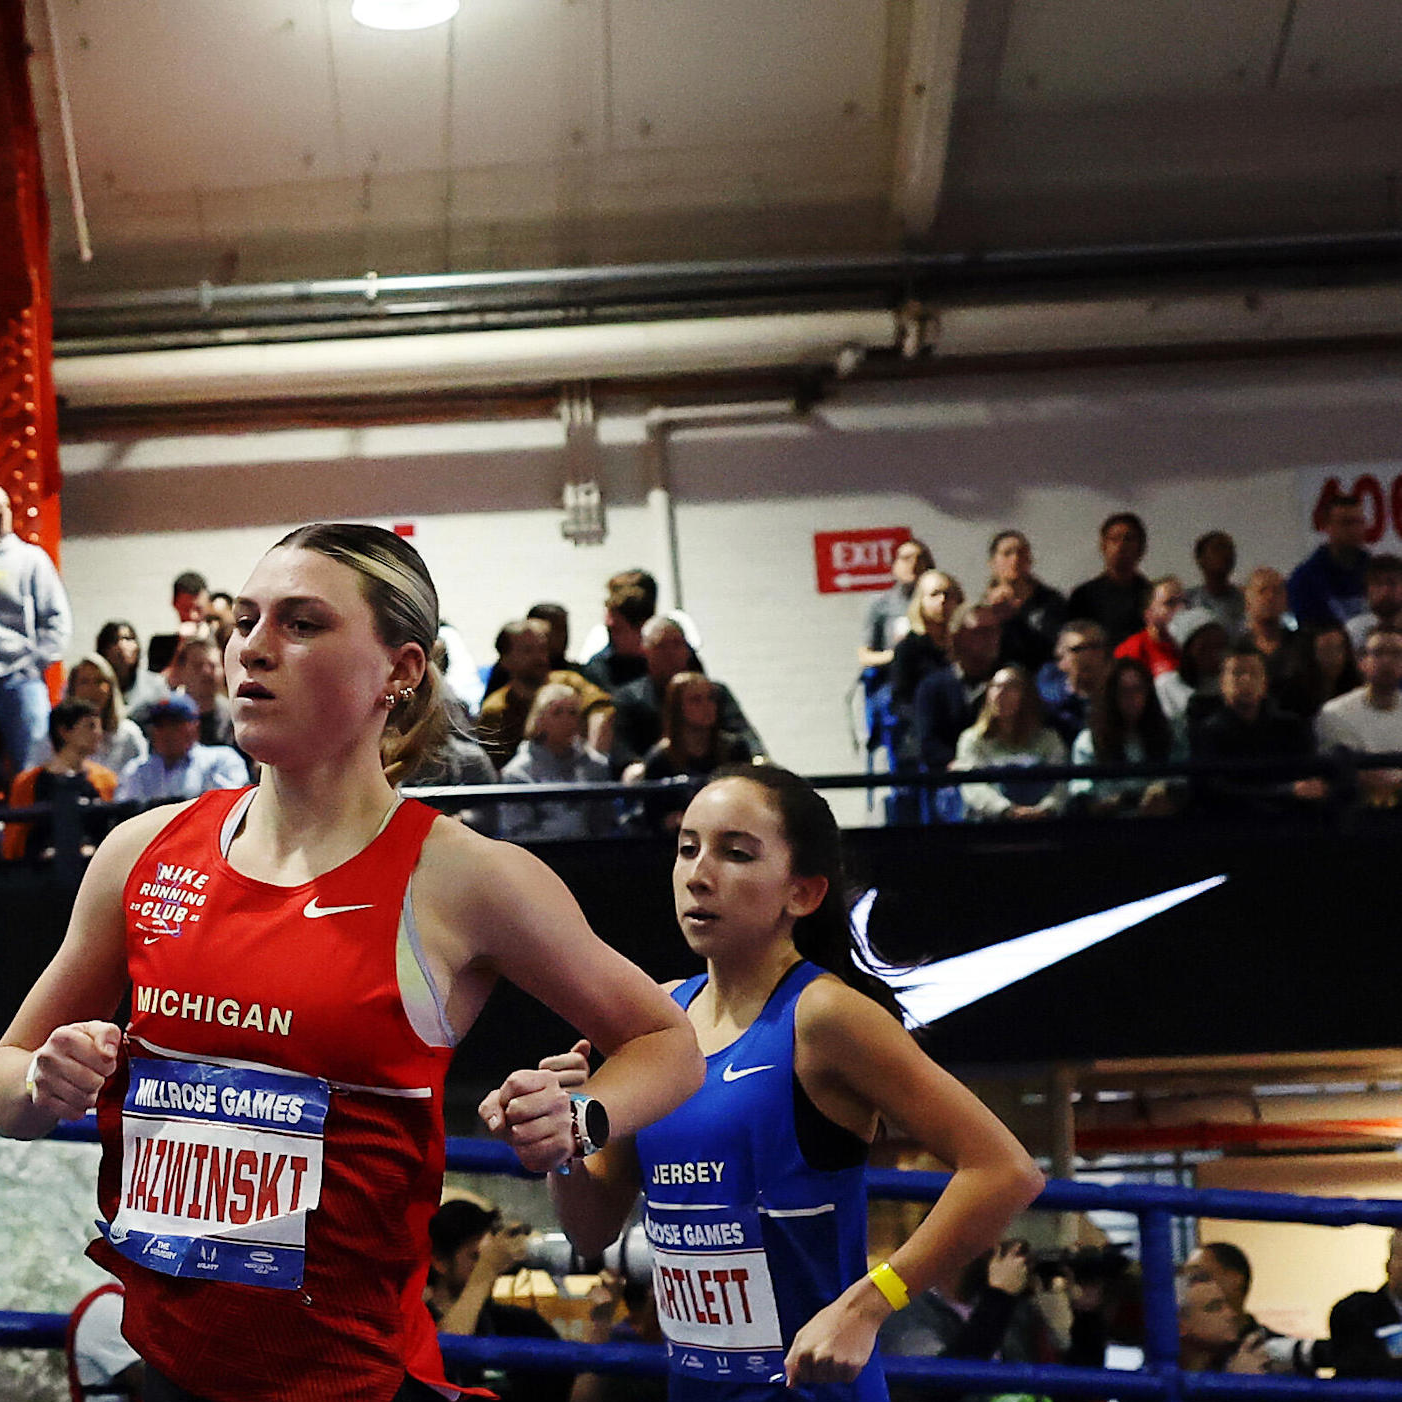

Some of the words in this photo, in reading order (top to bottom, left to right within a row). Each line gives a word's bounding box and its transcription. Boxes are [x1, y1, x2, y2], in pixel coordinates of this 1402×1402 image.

[832, 538, 895, 570] EXIT
[158, 864, 210, 890] NIKE
[139, 882, 207, 907] RUNNING
[141, 901, 189, 922] CLUB
[137, 985, 293, 1036] MICHIGAN
[135, 1078, 217, 1114] MILLROSE
[220, 1087, 306, 1124] GAMES
[126, 1136, 308, 1225] JAZWINSKI
[652, 1161, 725, 1185] JERSEY
[683, 1222, 745, 1246] GAMES
